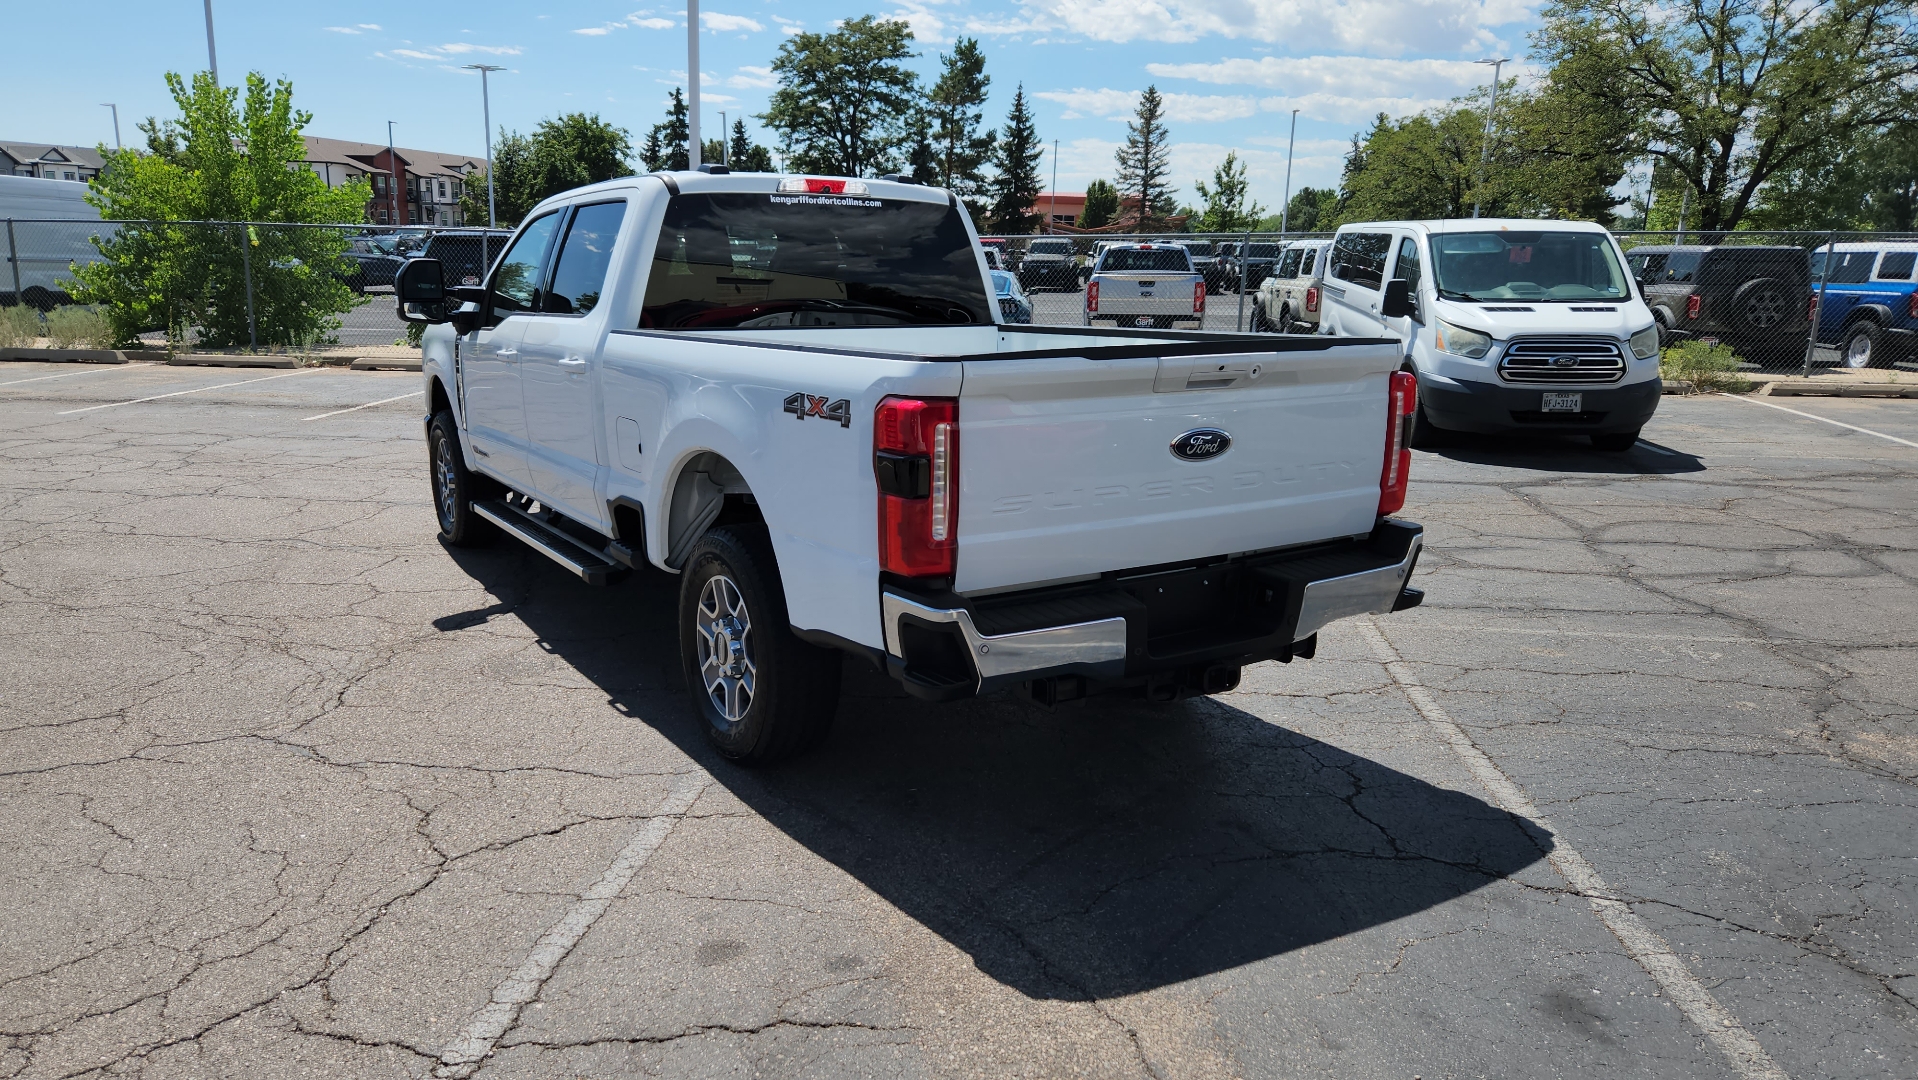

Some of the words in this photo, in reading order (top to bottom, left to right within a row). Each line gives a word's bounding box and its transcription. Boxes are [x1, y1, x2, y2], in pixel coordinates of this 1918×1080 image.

[1187, 435, 1220, 454] Ford
[991, 475, 1215, 517] SUPER
[1231, 458, 1367, 491] DUTY
